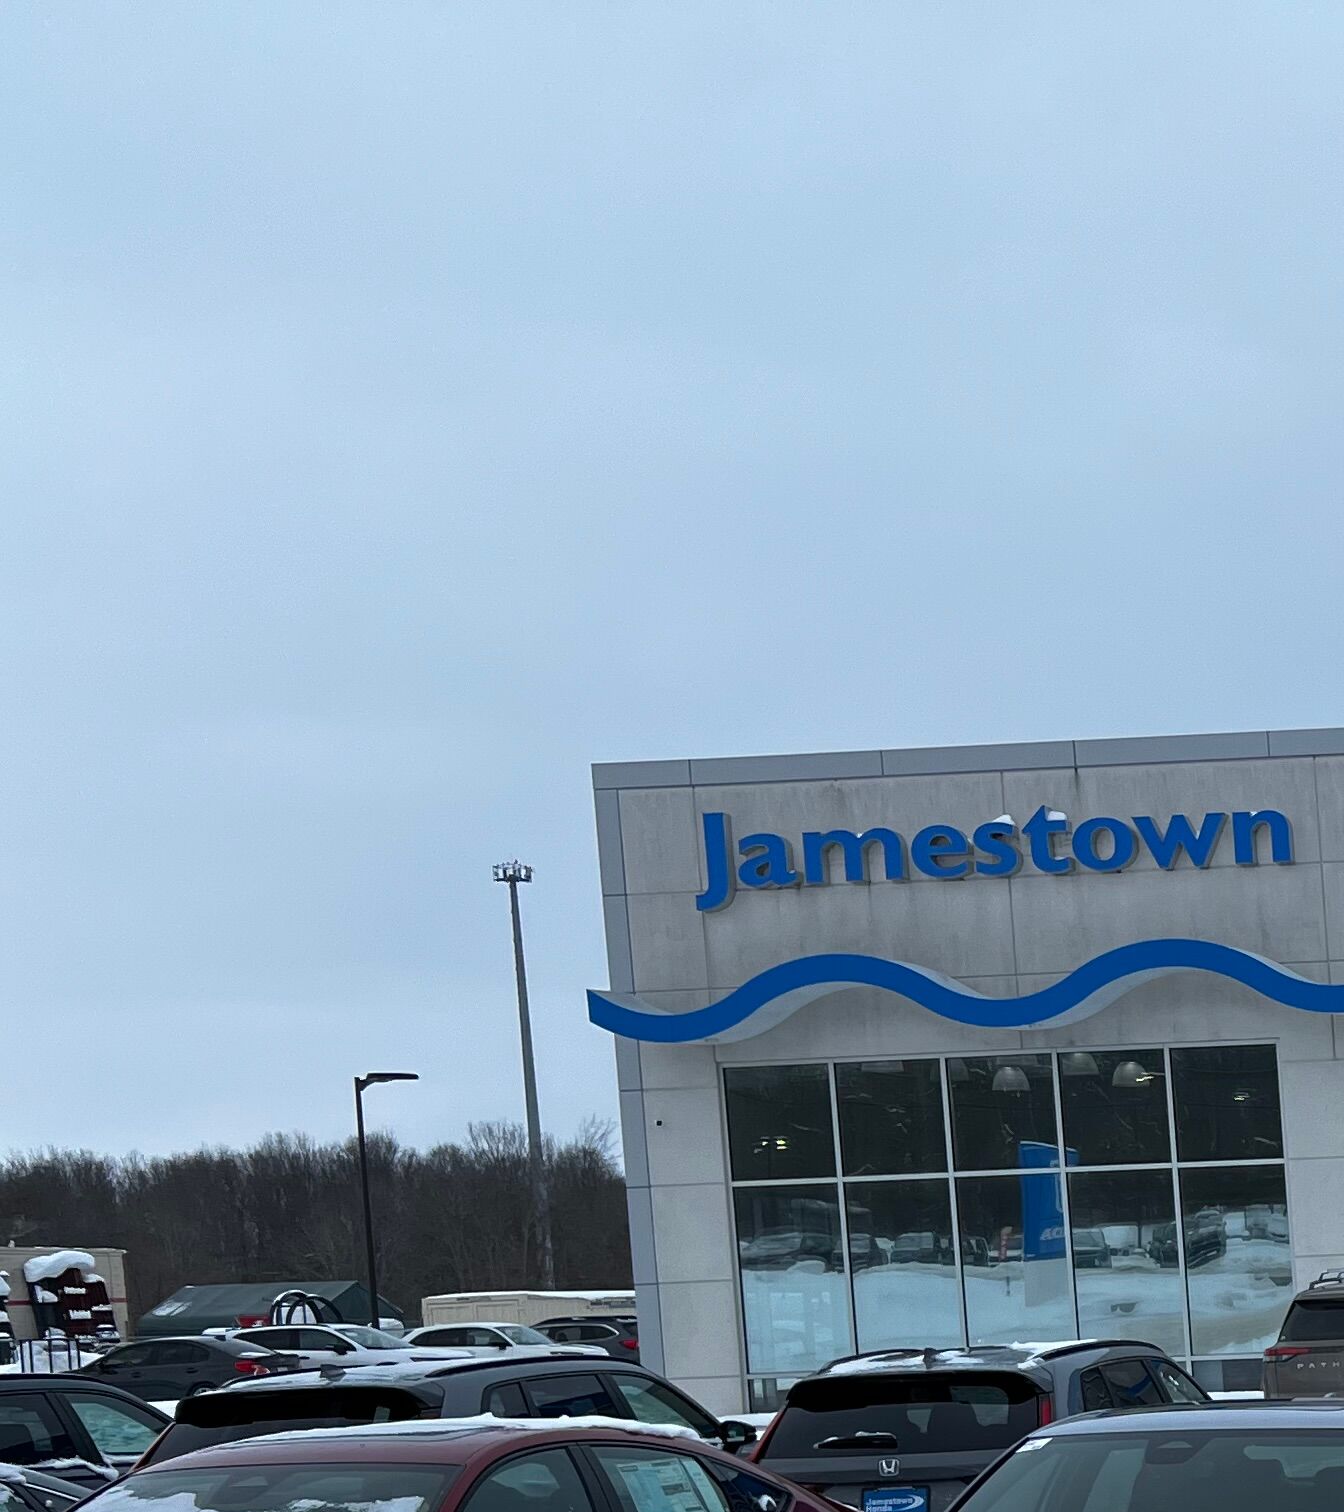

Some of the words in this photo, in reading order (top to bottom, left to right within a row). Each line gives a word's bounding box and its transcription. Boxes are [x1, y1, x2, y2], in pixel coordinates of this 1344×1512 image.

[695, 804, 1296, 912] Jamestown
[866, 1498, 913, 1506] Jamestown
[866, 1504, 892, 1512] Honda
